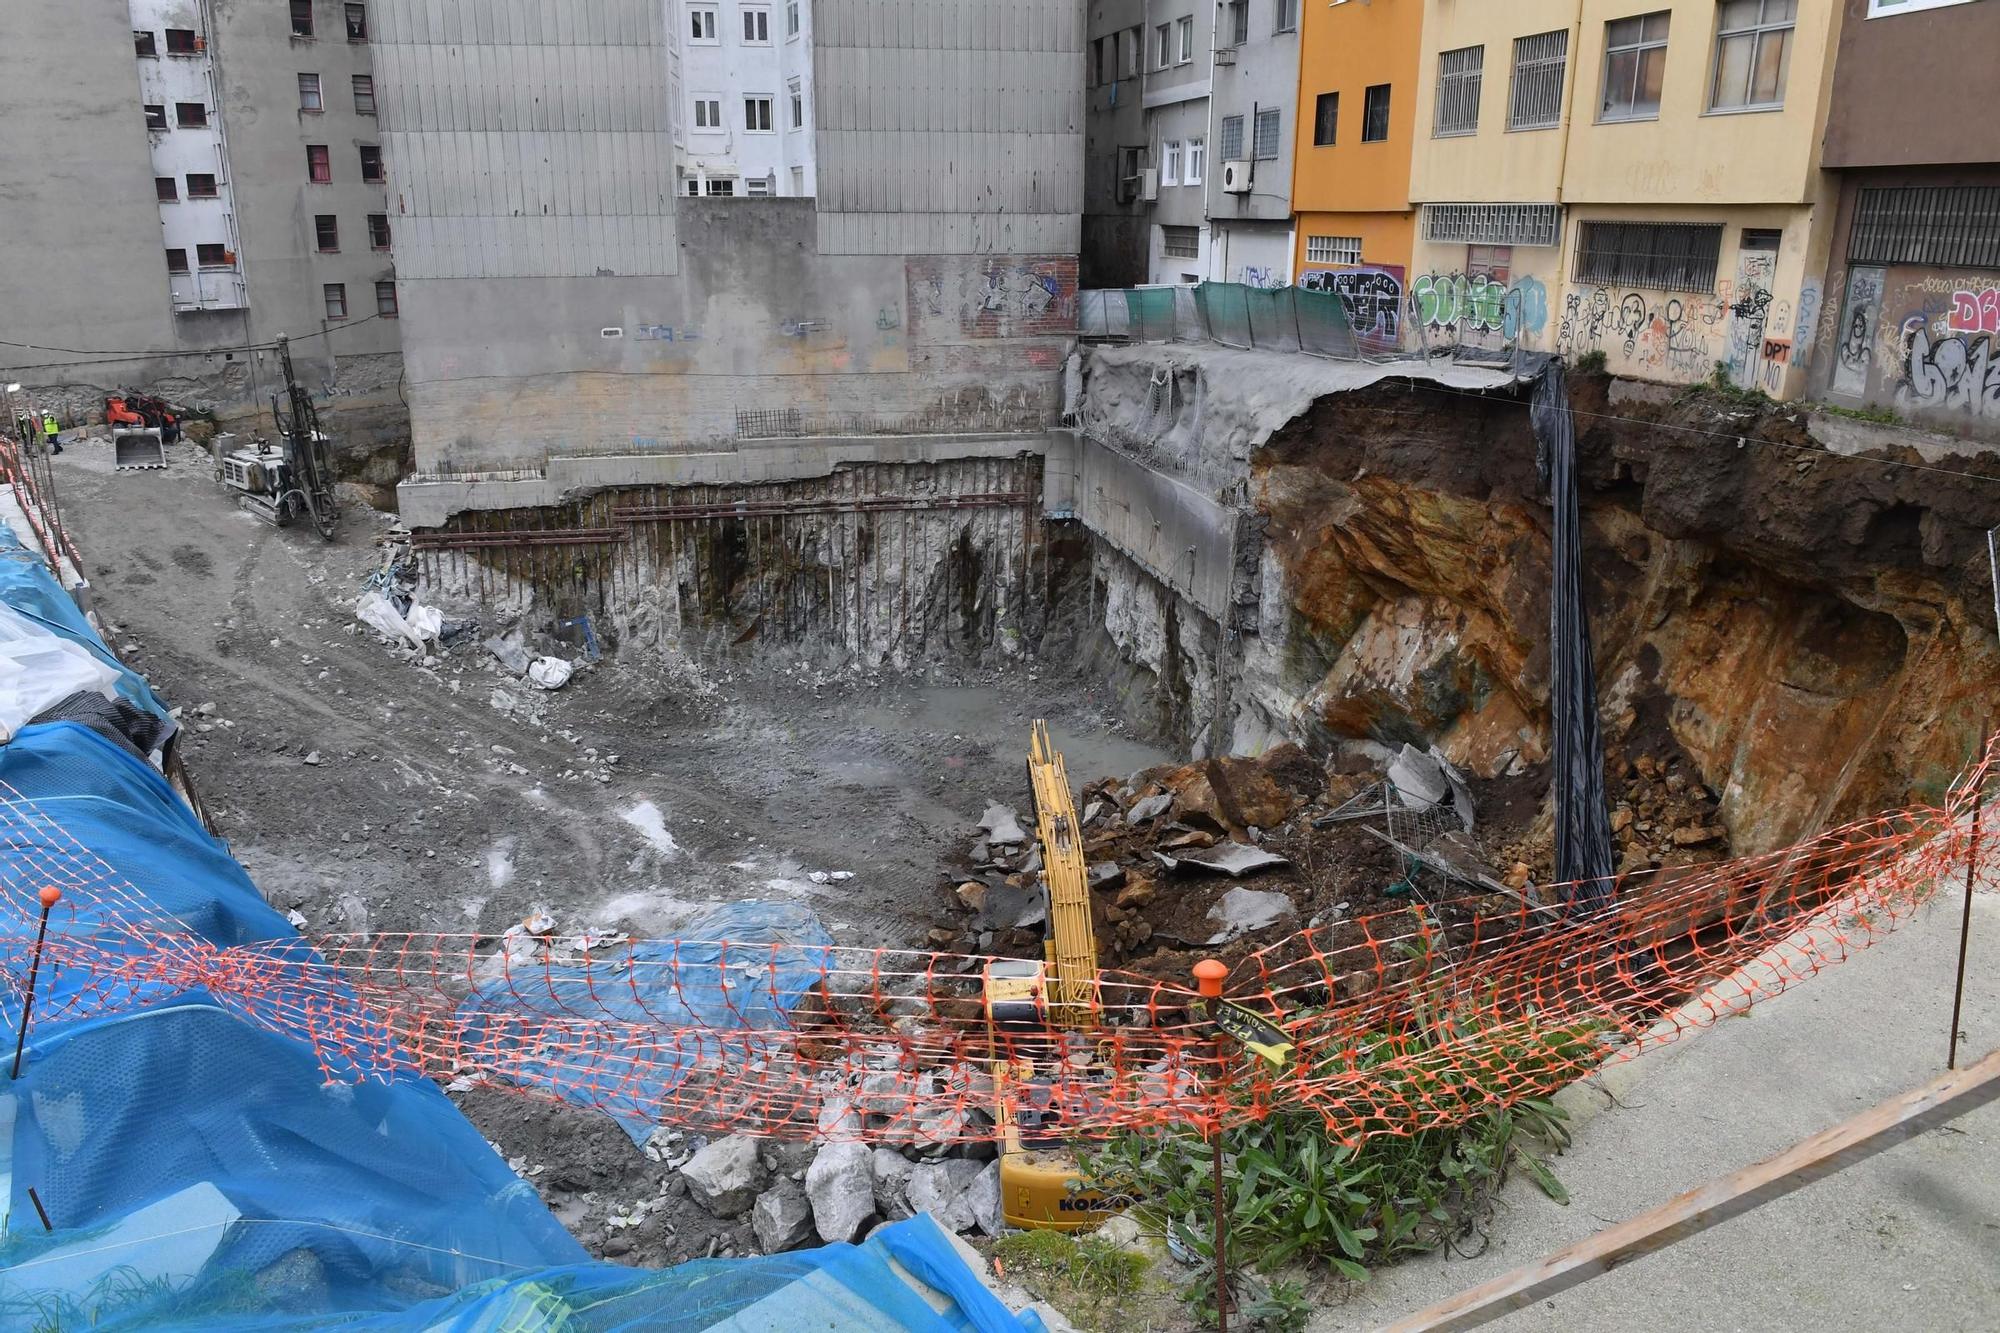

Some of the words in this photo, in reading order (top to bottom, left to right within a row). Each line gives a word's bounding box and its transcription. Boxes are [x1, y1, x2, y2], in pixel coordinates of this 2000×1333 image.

[1764, 341, 1790, 361] DPT
[1764, 362, 1781, 391] NO
[1235, 1011, 1266, 1032] ZONA
